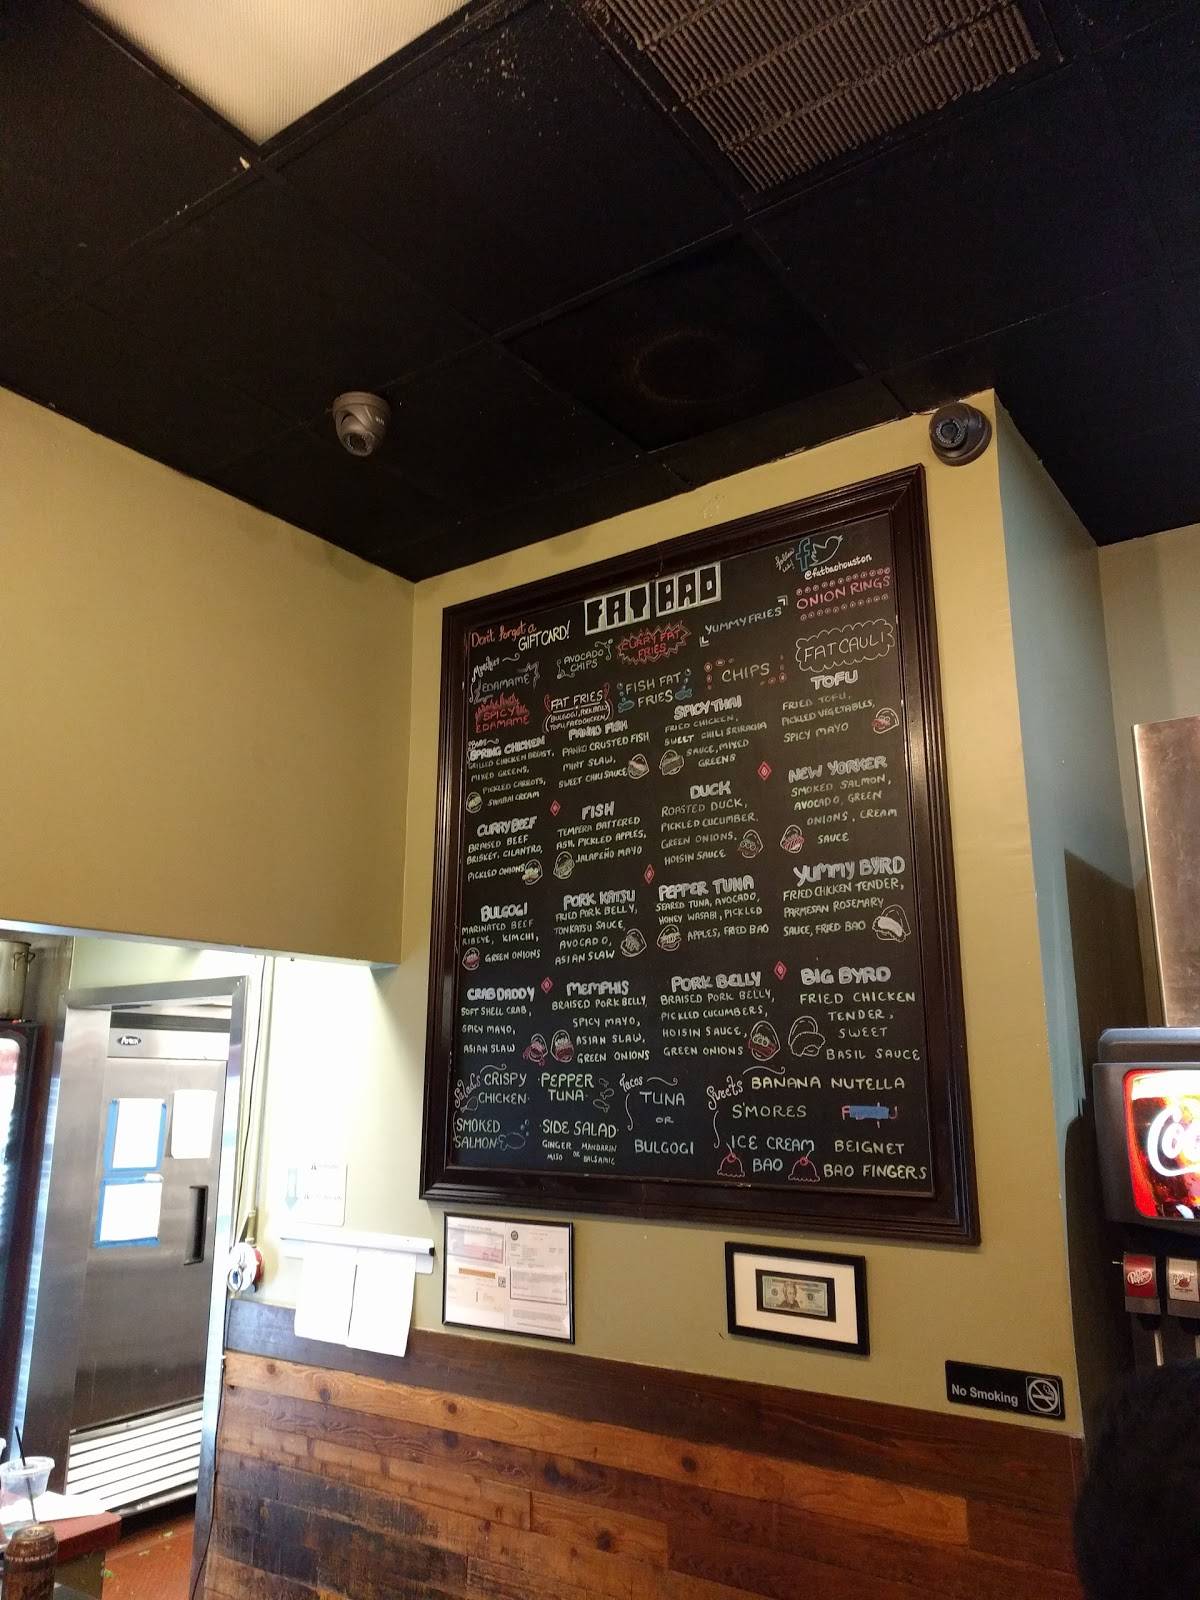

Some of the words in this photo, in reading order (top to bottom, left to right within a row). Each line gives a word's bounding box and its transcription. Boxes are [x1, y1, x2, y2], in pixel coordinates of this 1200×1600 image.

[804, 554, 873, 580] @fatbaohouston
[796, 586, 846, 609] ONION
[850, 575, 891, 595] RINGS
[748, 606, 783, 624] FRIES
[518, 631, 542, 651] GIFT
[564, 649, 604, 664] AVOCADO
[638, 643, 667, 658] FRIES
[804, 642, 837, 662] FAT
[570, 659, 598, 673] CHIPS
[721, 662, 770, 682] CHIPS
[482, 674, 530, 692] EDAMAME
[625, 677, 655, 694] FISH
[660, 671, 682, 687] FAT
[810, 669, 859, 690] TOFU
[551, 696, 570, 710] FAT
[573, 690, 603, 705] FRIES
[638, 690, 673, 708] FRIES
[782, 700, 813, 711] FRIED
[483, 705, 515, 721] SPICY
[674, 700, 710, 720] SPICY
[476, 715, 529, 733] EDAMAME
[605, 720, 628, 734] FISH
[781, 712, 816, 727] PICKLED
[665, 723, 690, 733] FRIED
[665, 734, 695, 746] SWEET
[701, 729, 724, 739] CHILI
[726, 721, 767, 735] SRIRACHA
[784, 728, 811, 744] SPICY
[816, 722, 849, 738] MAYO
[504, 736, 545, 754] CHICKEN
[589, 737, 628, 751] CRUSTED
[631, 732, 650, 744] FISH
[719, 739, 749, 751] MIXED
[563, 760, 584, 771] MINT
[698, 753, 736, 767] GREENS
[788, 764, 823, 783] NEW
[827, 756, 888, 775] YORKER
[559, 776, 582, 789] SWEET
[604, 767, 628, 778] SAUCE
[690, 780, 732, 800] DUCK
[791, 783, 833, 798] SMOKED
[848, 790, 882, 803] GREEN
[581, 801, 615, 820] FISH
[661, 803, 705, 818] ROASTED
[860, 808, 898, 819] CREAM
[477, 820, 512, 837] CURRY
[596, 816, 640, 831] BATTERED
[661, 819, 700, 832] PICKLED
[506, 834, 529, 846] BEEF
[578, 835, 612, 847] PICKLED
[661, 836, 691, 849] GREEN
[818, 832, 849, 844] SAUCE
[617, 846, 643, 857] MAYO
[664, 852, 695, 866] HOISIN
[696, 849, 727, 860] SAUCE
[468, 868, 497, 882] PICKLED
[499, 863, 526, 876] ONIONS
[793, 861, 855, 887] YUMMY
[859, 856, 906, 876] BYRD
[658, 881, 709, 902] PEPPER
[712, 875, 755, 895] TUNA
[783, 889, 812, 901] FRIED
[814, 882, 852, 896] CHICKEN
[563, 892, 597, 911] PORK
[599, 889, 636, 904] KATSU
[655, 901, 685, 912] SEARED
[784, 905, 829, 918] PARMESAN
[833, 897, 884, 912] ROSEMARY
[480, 902, 528, 922] BULGOGI
[555, 912, 578, 922] FRIED
[580, 907, 601, 919] PORK
[659, 914, 683, 925] HONEY
[724, 907, 763, 919] PICKLED
[462, 923, 506, 935] MARINATED
[511, 919, 534, 929] BEEF
[554, 924, 592, 935] TONKATSU
[724, 925, 747, 936] FRIED
[749, 924, 769, 934] BAO
[815, 922, 841, 935] FRIED
[845, 920, 866, 932] BAO
[485, 952, 510, 963] GREEN
[512, 949, 541, 960] ONIONS
[555, 953, 585, 966] ASIAN
[588, 950, 615, 961] SLAW
[671, 975, 713, 993] PORK
[715, 971, 761, 989] BELLY
[800, 968, 834, 985] BIG
[839, 966, 891, 984] BYRD
[467, 987, 496, 1001] CRAB
[496, 986, 535, 1002] DADDY
[566, 980, 629, 996] MEMPHIS
[551, 1000, 591, 1011] BRAISED
[595, 998, 620, 1008] PORK
[660, 994, 702, 1005] BRAISED
[707, 992, 734, 1002] PORK
[800, 993, 843, 1005] FRIED
[853, 991, 916, 1003] CHICKEN
[461, 1007, 479, 1017] SOFT
[481, 1006, 504, 1016] SHELL
[661, 1010, 699, 1021] PICKLED
[462, 1024, 483, 1034] SPICY
[572, 1017, 600, 1028] SPICY
[662, 1028, 701, 1038] HOISIN
[839, 1027, 888, 1038] SWEET
[576, 1036, 606, 1046] ASIAN
[463, 1044, 488, 1054] ASIAN
[490, 1044, 516, 1053] SLAW
[664, 1046, 698, 1056] GREEN
[703, 1046, 743, 1056] ONIONS
[826, 1048, 866, 1060] BASIL
[875, 1048, 920, 1061] SAUCE
[577, 1053, 607, 1064] GREEN
[614, 1050, 650, 1061] ONIONS
[484, 1072, 527, 1087] CRISPY
[541, 1072, 594, 1089] PEPPER
[752, 1076, 821, 1090] BANANA
[831, 1077, 905, 1090] NUTELLA
[478, 1092, 527, 1104] CHICKEN
[548, 1089, 585, 1101] TUNA
[639, 1091, 685, 1106] TUNA
[706, 1075, 743, 1110] Sweets
[732, 1101, 807, 1119] S'MORES
[456, 1118, 500, 1133] SMOKED
[655, 1116, 674, 1125] OR
[542, 1119, 570, 1135] SIDE
[573, 1120, 617, 1138] SALAD
[454, 1136, 498, 1149] SALMON
[542, 1140, 572, 1150] GINGER
[634, 1139, 694, 1155] BULGOGI
[731, 1135, 758, 1150] ICE
[766, 1136, 814, 1152] CREAM
[834, 1139, 904, 1155] BEIGNET
[753, 1158, 783, 1173] BAO
[823, 1163, 854, 1178] BAO
[863, 1164, 928, 1180] FINGERS
[951, 1383, 967, 1396] No
[969, 1387, 1019, 1407] Smoking
